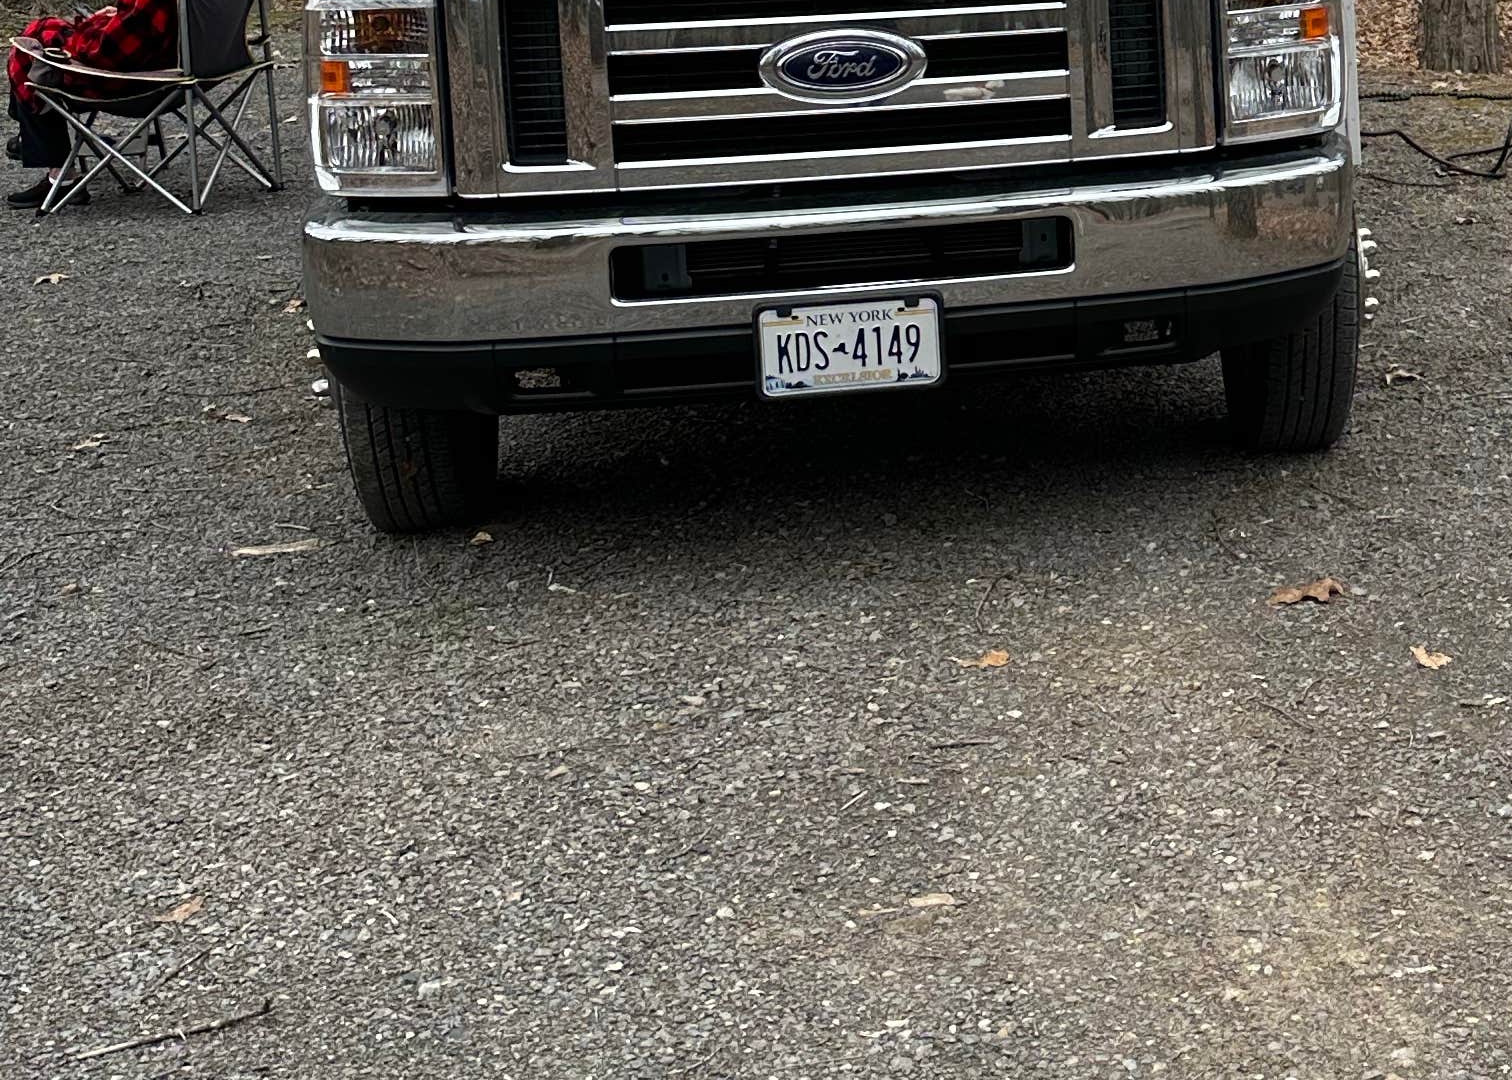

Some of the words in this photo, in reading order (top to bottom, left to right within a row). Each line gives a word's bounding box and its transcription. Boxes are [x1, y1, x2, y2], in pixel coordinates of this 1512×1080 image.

[807, 50, 877, 79] Ford
[806, 312, 844, 326] NEW
[849, 308, 893, 322] YORK
